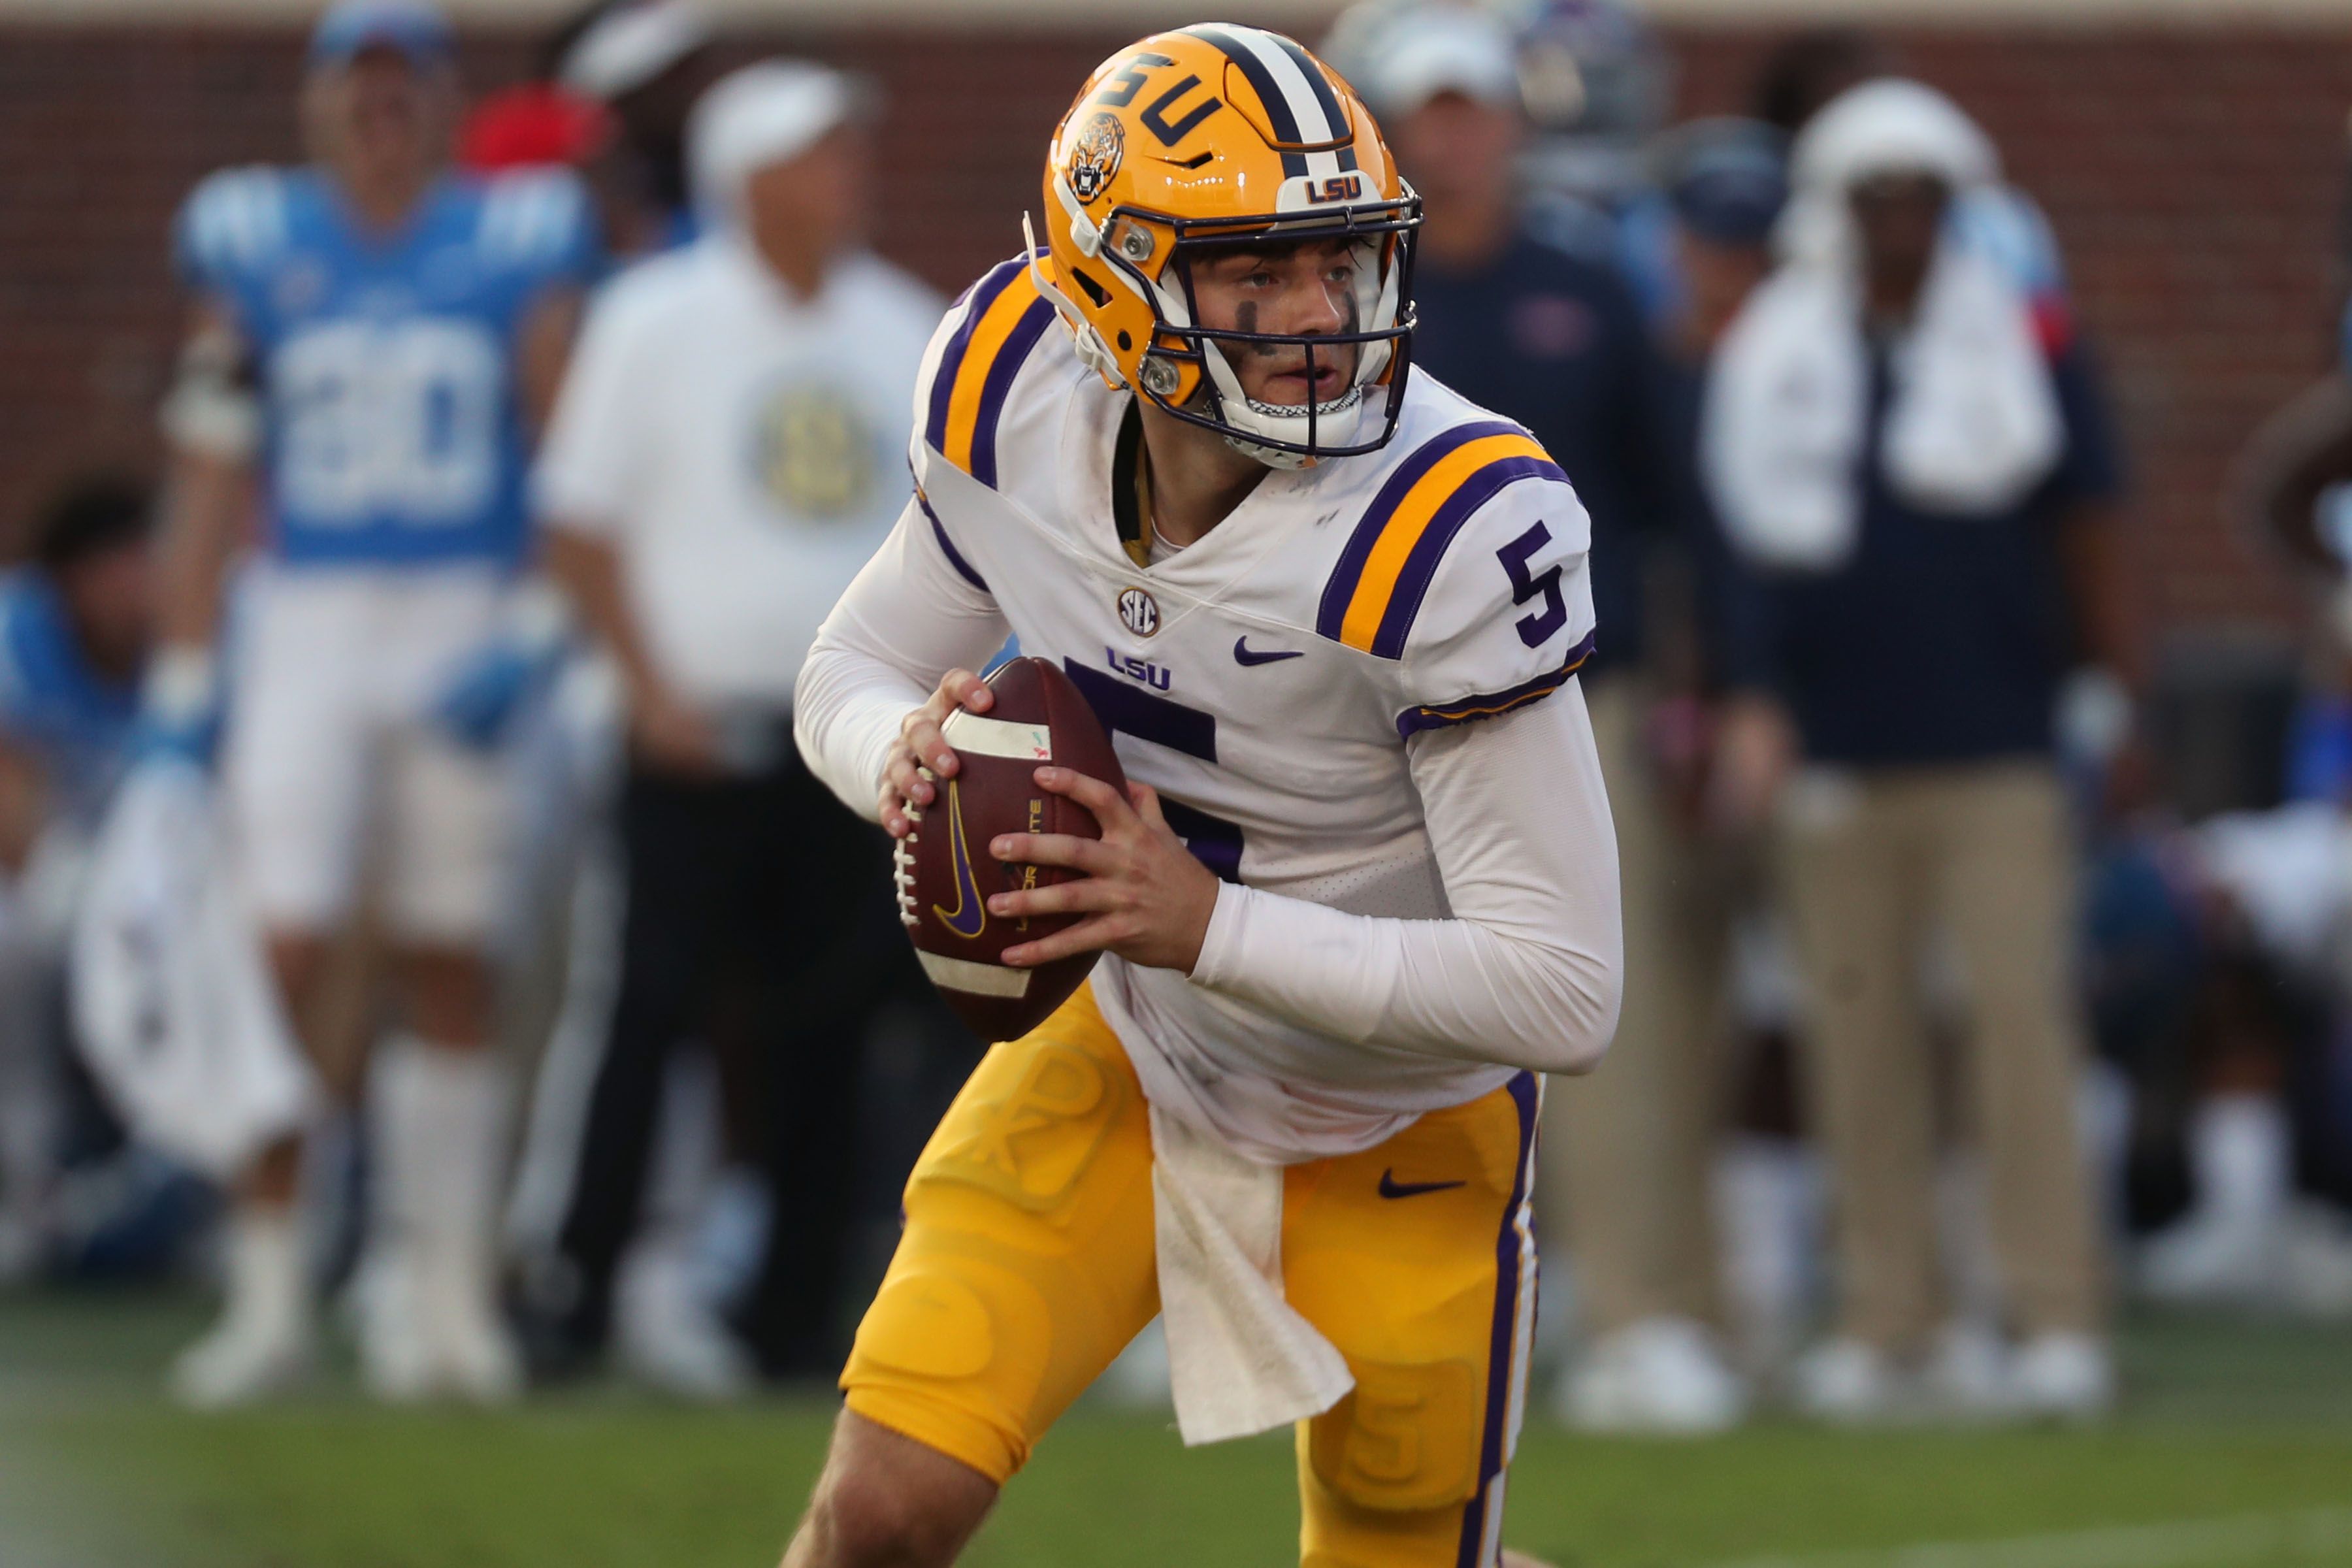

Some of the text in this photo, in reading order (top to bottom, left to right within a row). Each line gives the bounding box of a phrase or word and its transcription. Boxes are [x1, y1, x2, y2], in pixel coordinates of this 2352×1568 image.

[1304, 176, 1362, 204] LSU
[1496, 519, 1567, 649] 5
[1120, 589, 1157, 634] SEC
[1105, 645, 1171, 691] LSU
